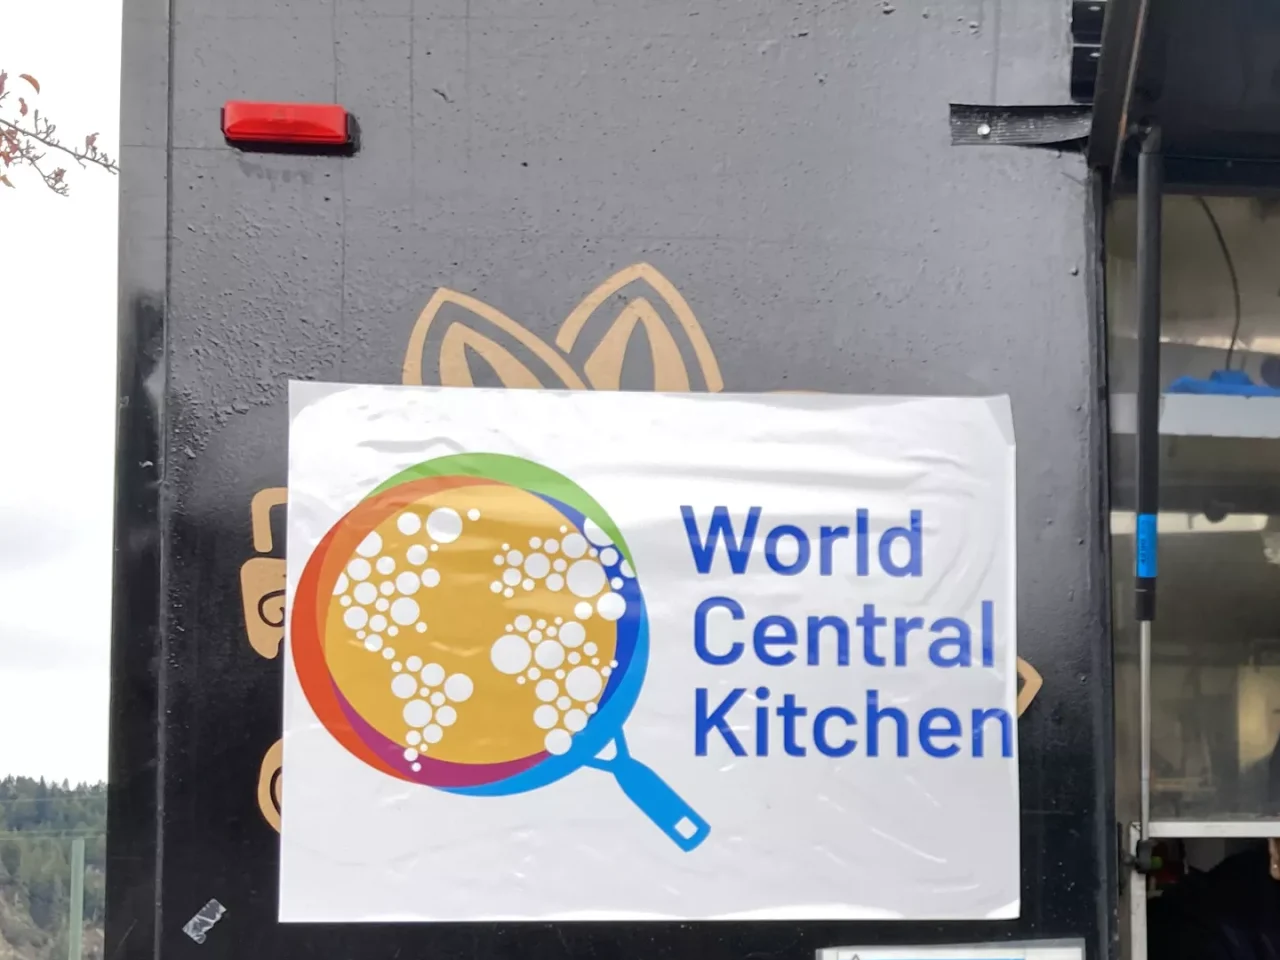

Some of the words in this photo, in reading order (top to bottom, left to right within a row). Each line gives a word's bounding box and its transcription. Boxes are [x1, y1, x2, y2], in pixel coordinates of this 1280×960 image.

[680, 505, 924, 578] World
[693, 595, 995, 668] Central
[694, 686, 1015, 759] Kitchen
